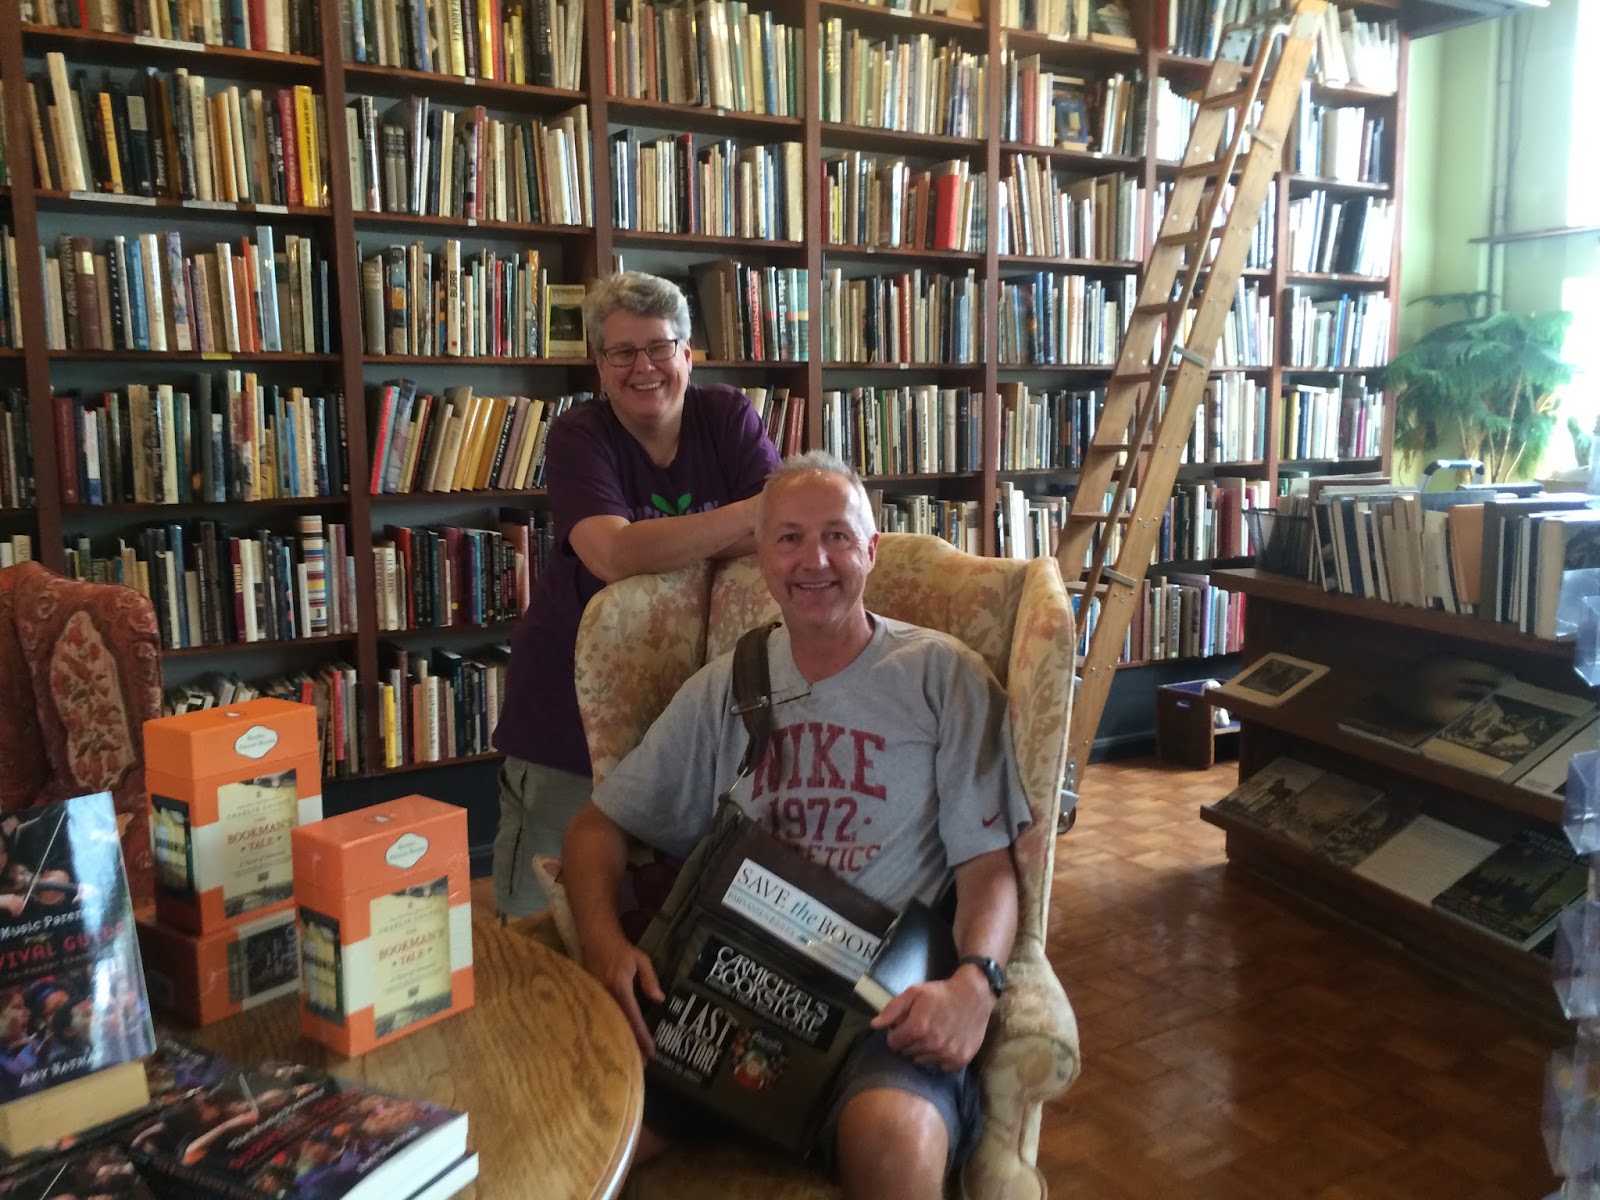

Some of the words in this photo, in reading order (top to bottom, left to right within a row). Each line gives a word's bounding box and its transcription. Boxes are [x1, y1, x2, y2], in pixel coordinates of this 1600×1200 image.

[778, 279, 786, 303] Max
[779, 305, 787, 333] Ernst
[752, 722, 887, 801] NIKE
[227, 817, 294, 845] BOOKMAN'S
[249, 837, 273, 851] TALE
[737, 866, 791, 907] SAVE
[790, 900, 818, 925] the
[0, 919, 42, 940] Music
[43, 909, 82, 929] Paren
[401, 950, 424, 966] TALE
[710, 962, 824, 1035] BOOKSTORE
[677, 993, 740, 1048] LAST
[653, 1018, 722, 1077] BOOKSTORE
